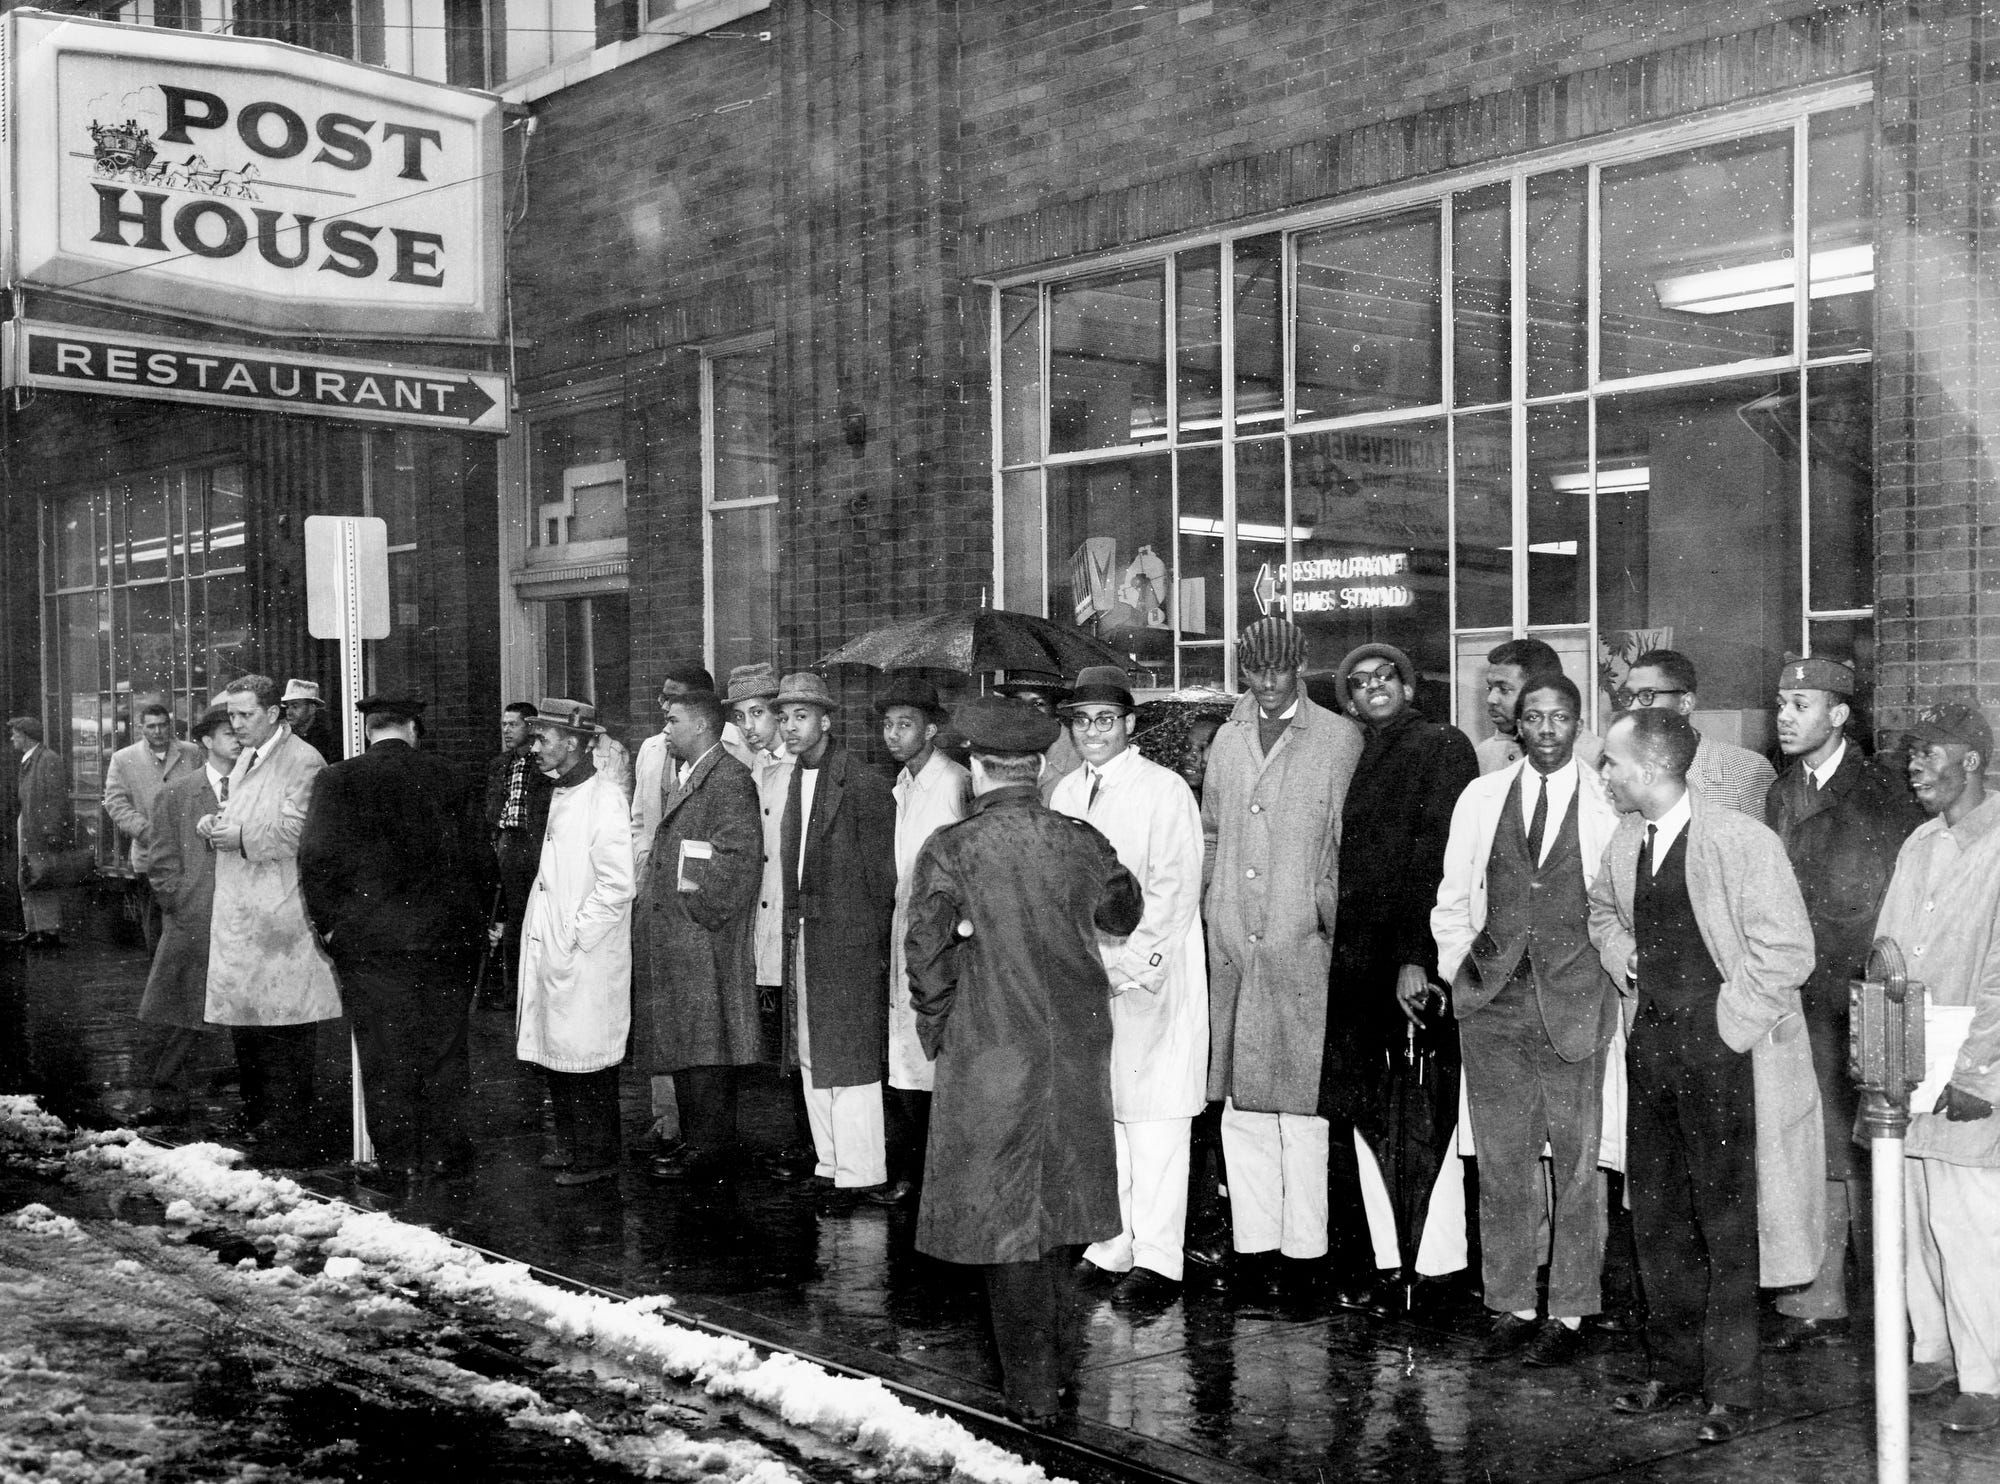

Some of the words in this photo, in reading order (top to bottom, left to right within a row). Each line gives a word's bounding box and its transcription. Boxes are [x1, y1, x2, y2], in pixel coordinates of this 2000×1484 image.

[158, 84, 443, 182] POST
[89, 183, 445, 288] HOUSE
[56, 342, 456, 413] RESTAURANT
